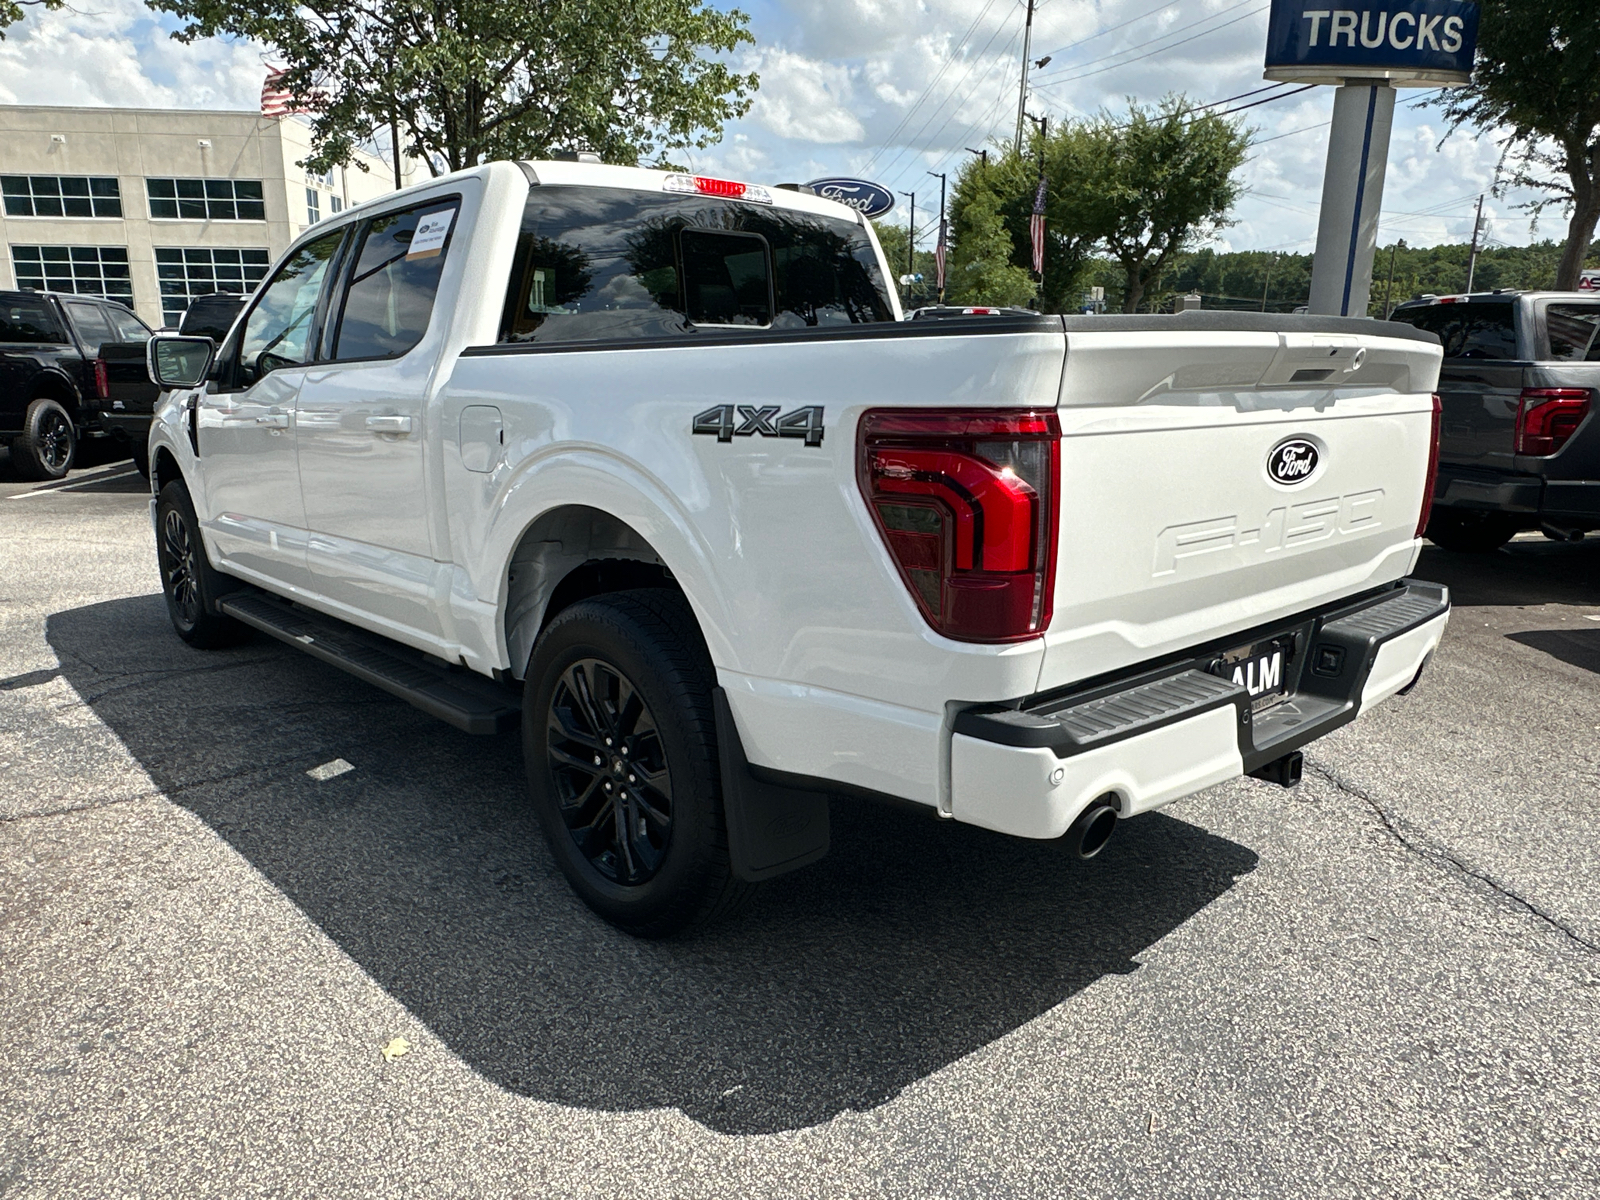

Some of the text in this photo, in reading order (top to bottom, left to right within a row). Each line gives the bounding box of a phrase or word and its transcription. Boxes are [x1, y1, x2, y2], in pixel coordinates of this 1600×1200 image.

[1302, 10, 1464, 53] TRUCKS
[1277, 446, 1313, 478] Ford
[1151, 488, 1386, 578] F-150
